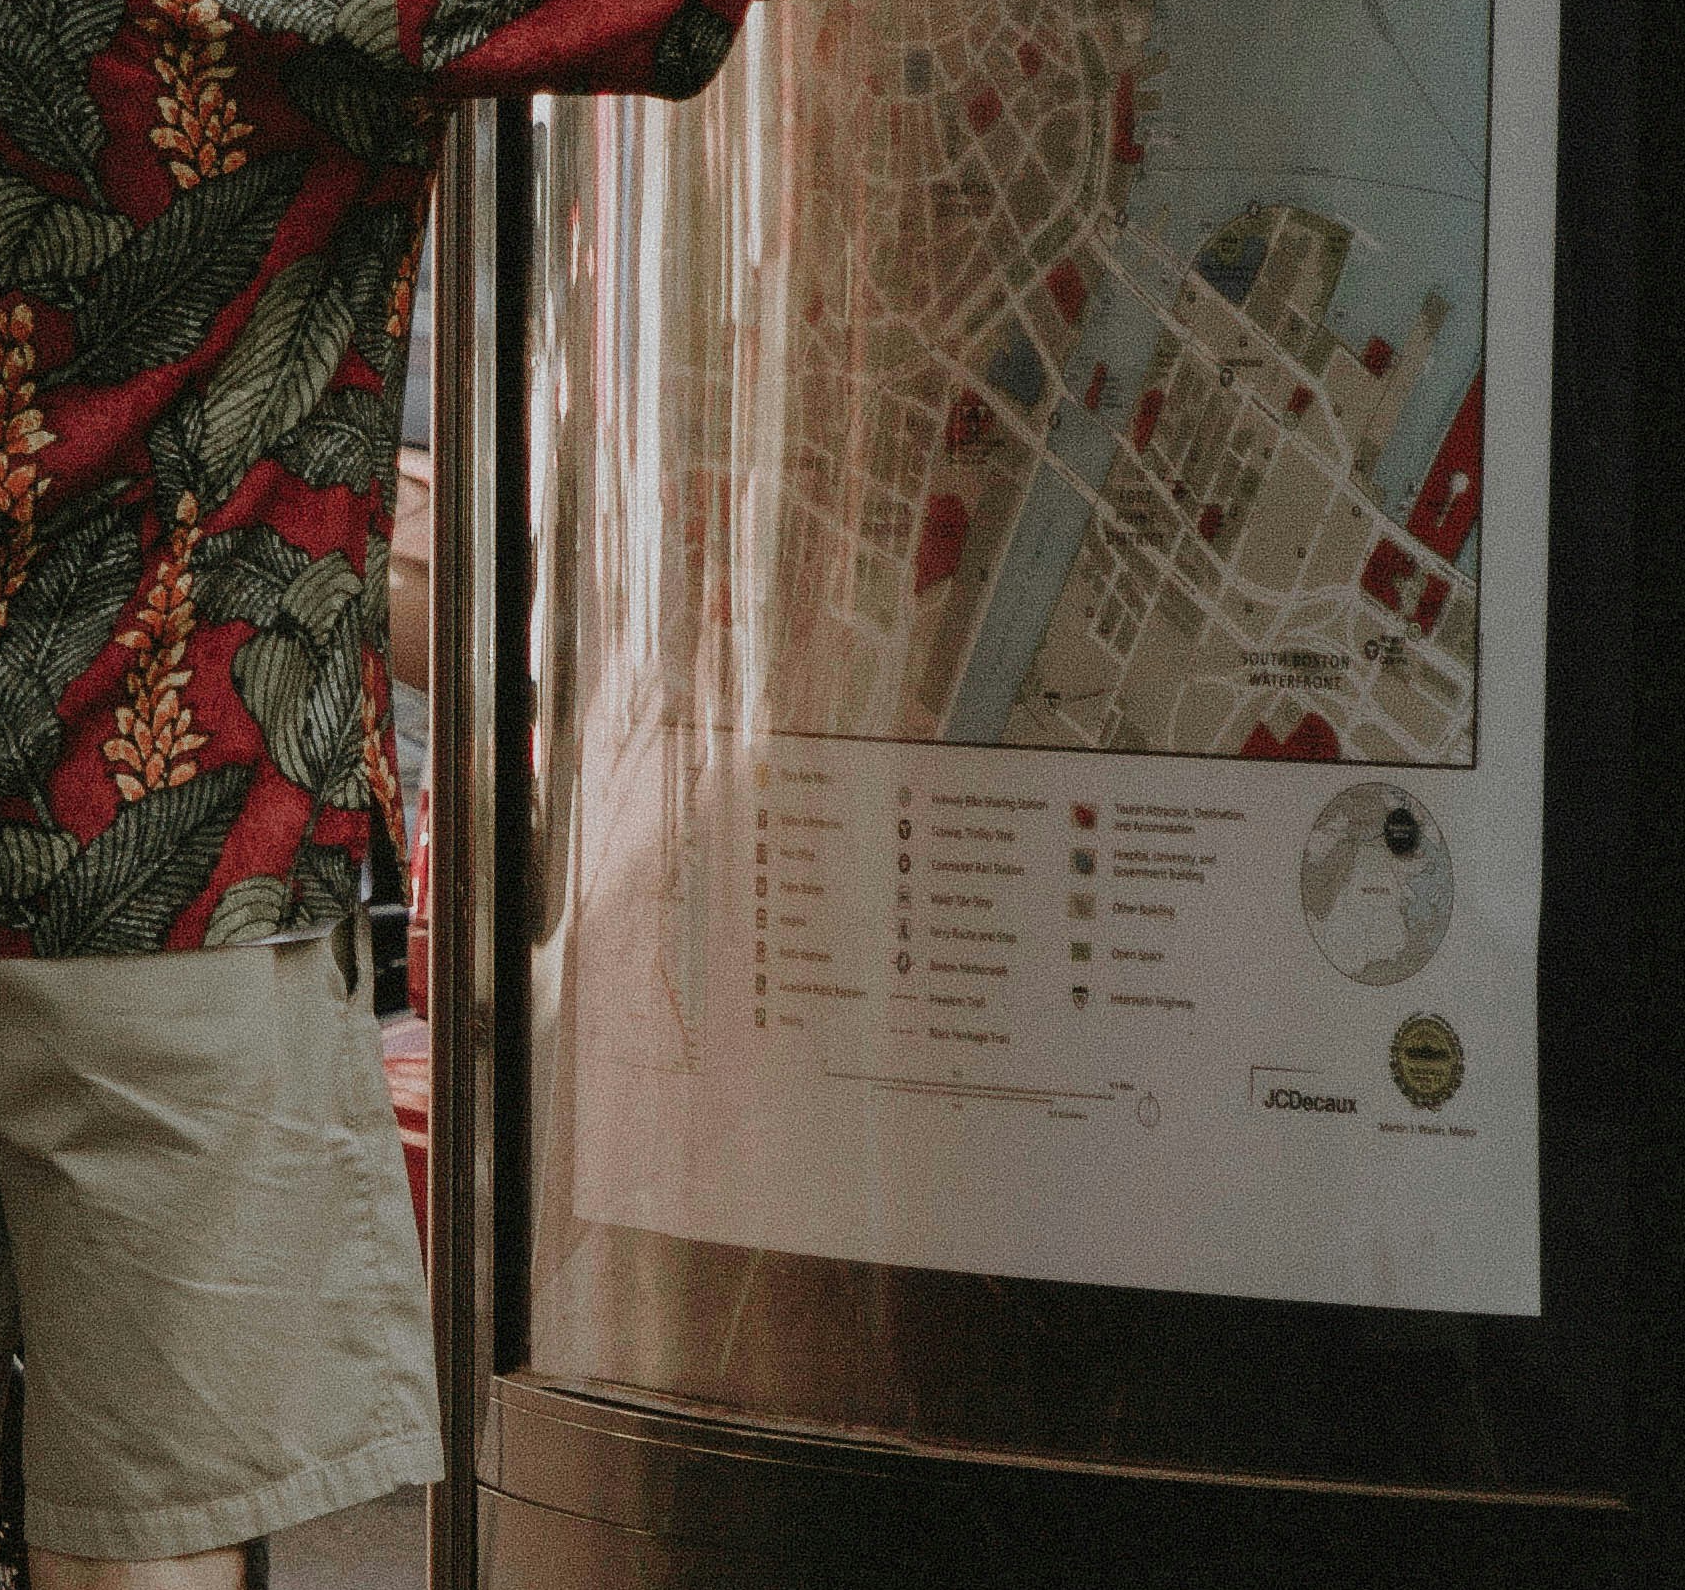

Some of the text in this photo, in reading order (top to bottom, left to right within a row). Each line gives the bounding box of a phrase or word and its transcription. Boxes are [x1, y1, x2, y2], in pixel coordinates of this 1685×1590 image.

[1241, 651, 1351, 669] SOUTH BOSTON
[1248, 673, 1342, 690] WATERFRONT
[1263, 1088, 1358, 1114] JCDecaux
